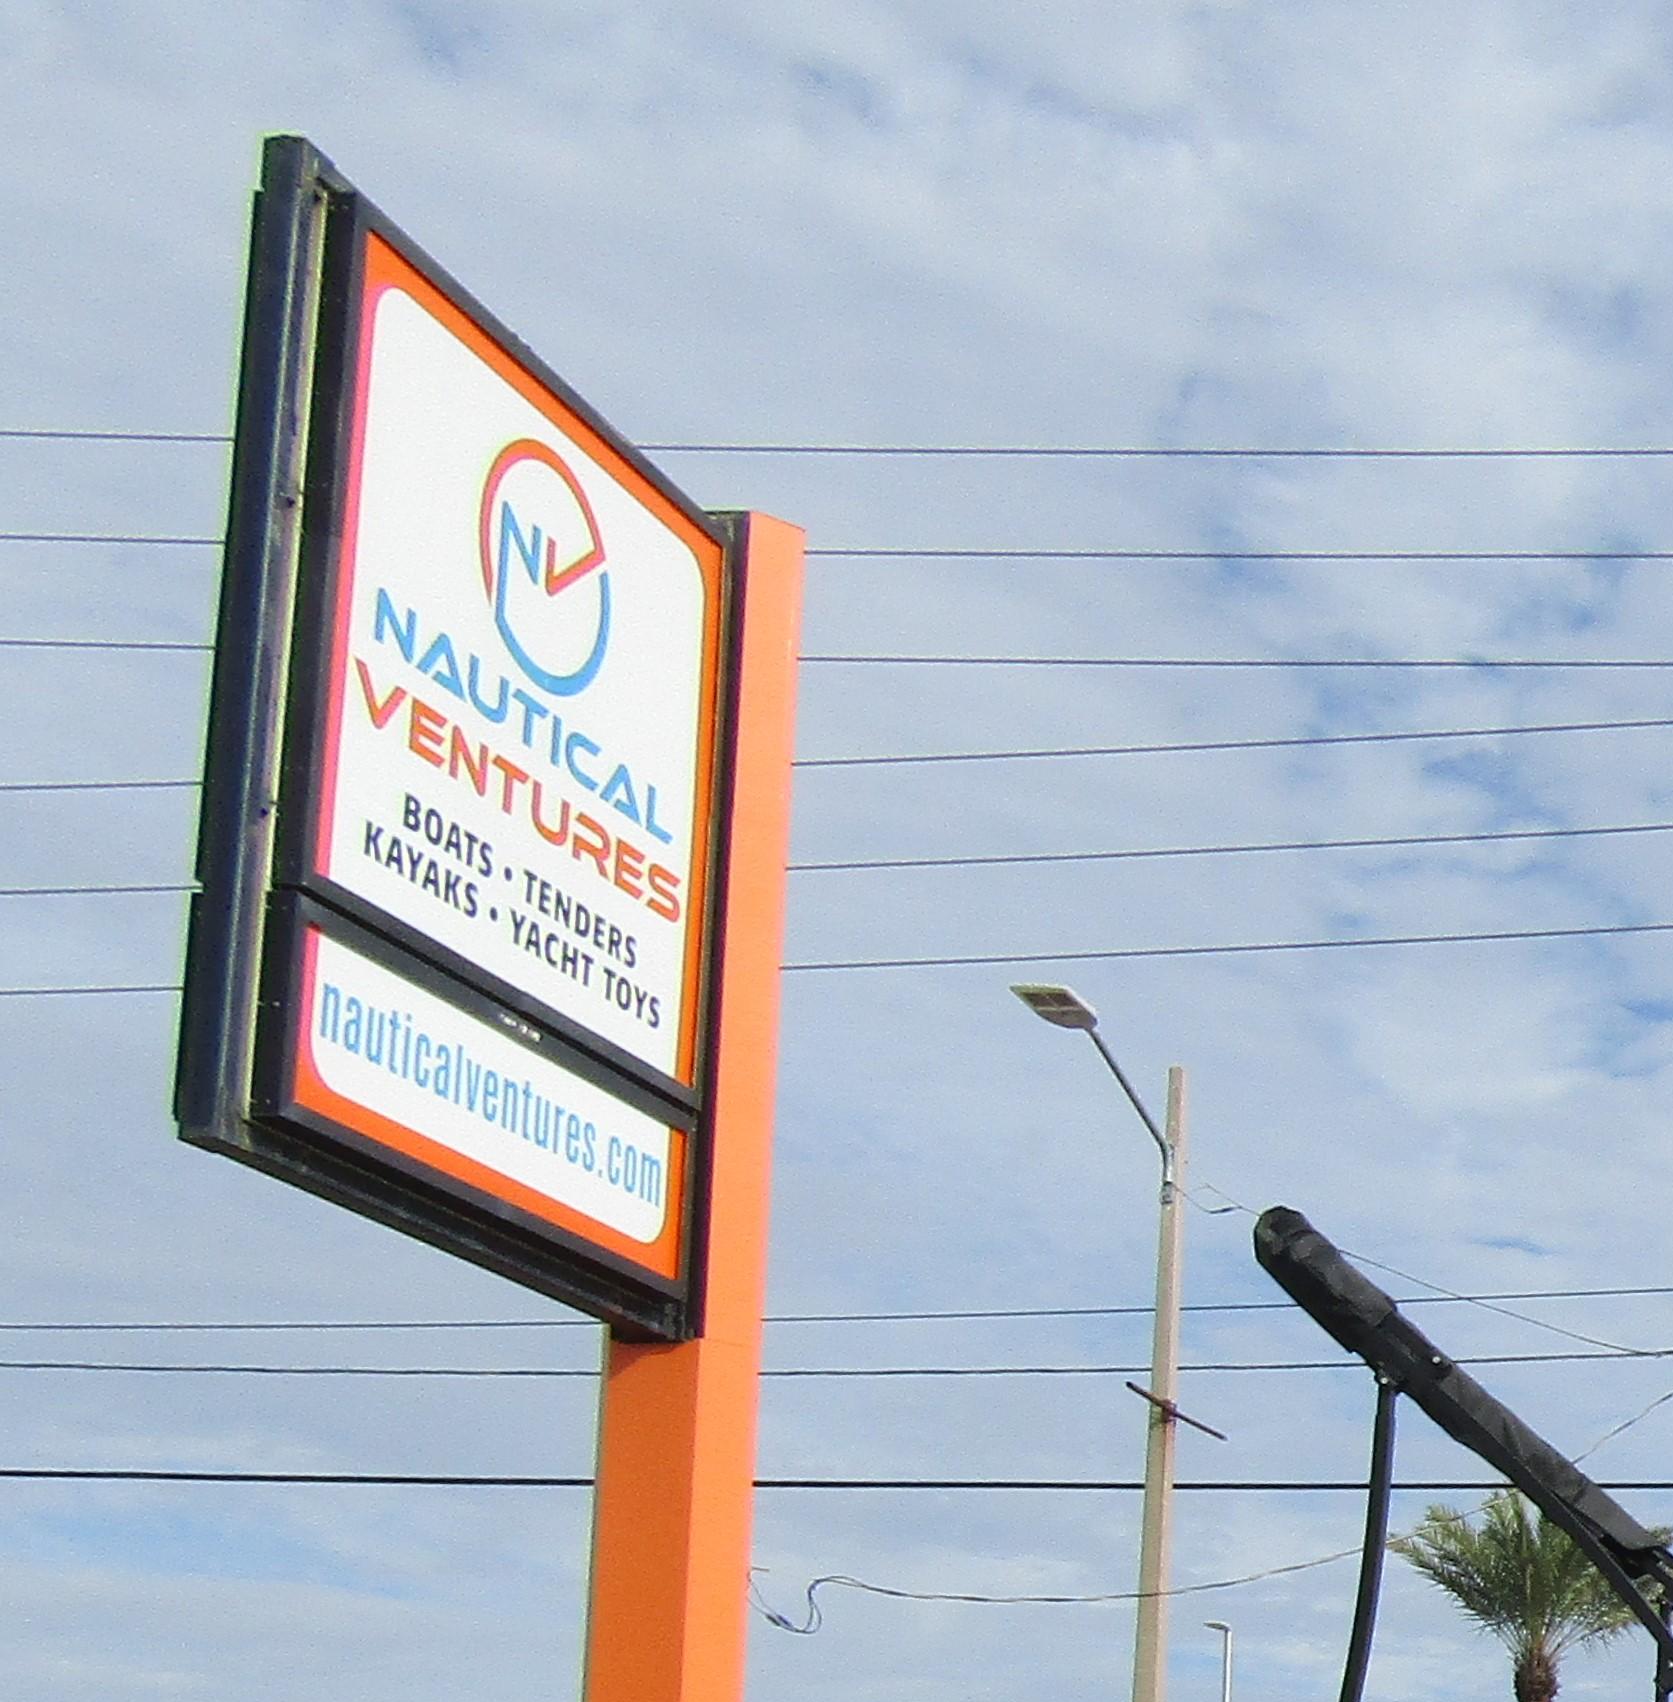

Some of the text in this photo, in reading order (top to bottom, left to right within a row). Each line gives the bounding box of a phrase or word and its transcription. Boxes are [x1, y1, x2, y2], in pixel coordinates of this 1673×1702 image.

[354, 655, 681, 923] VENTURES
[374, 588, 673, 844] NAUTICAL
[363, 820, 661, 1028] KAYAKS YACHT TOYS
[402, 791, 638, 969] BOATS TENDERS
[320, 982, 662, 1206] nauticalventures.com
